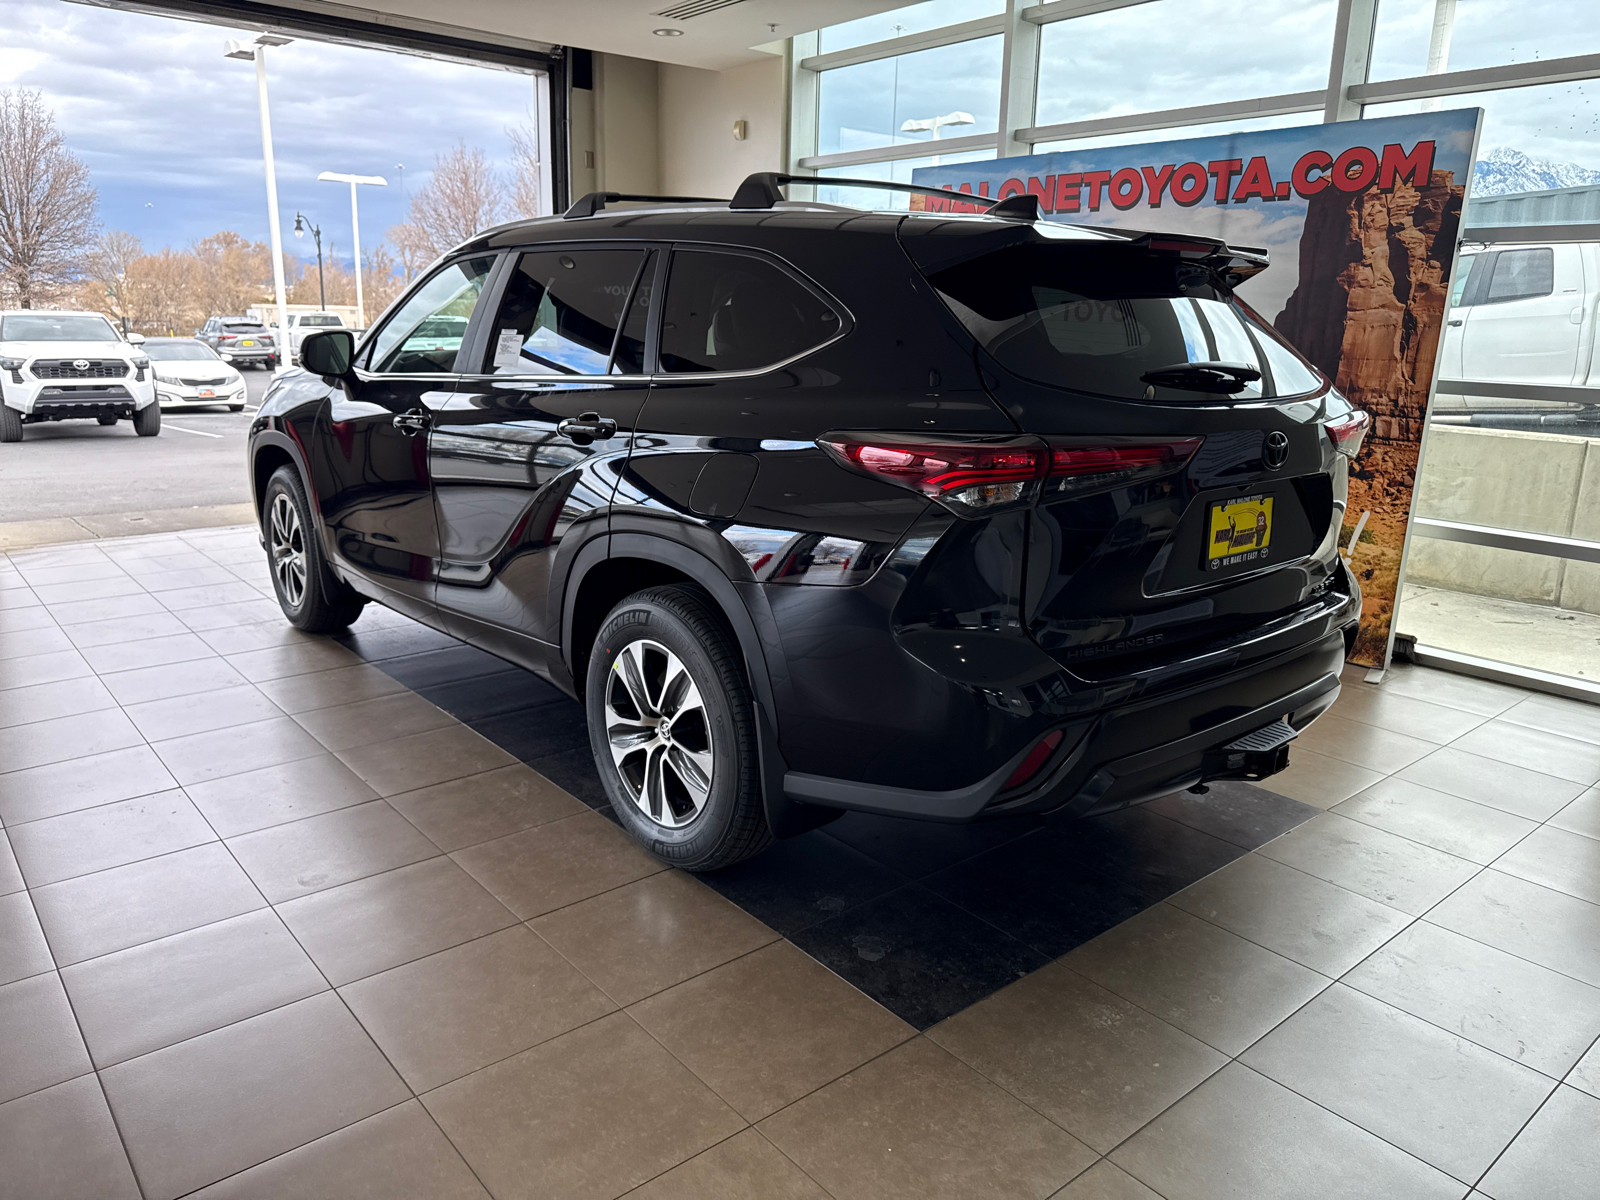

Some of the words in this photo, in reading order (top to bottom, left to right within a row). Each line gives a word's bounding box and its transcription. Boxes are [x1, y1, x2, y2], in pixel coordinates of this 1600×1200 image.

[925, 140, 1436, 214] MALONETOYOTA.COM
[1258, 516, 1265, 525] 32
[1223, 557, 1229, 566] WE
[1231, 554, 1242, 563] MAKE
[1242, 553, 1247, 561] IT
[1248, 551, 1258, 560] EASY
[602, 611, 648, 642] MICHELIN
[1066, 633, 1164, 660] HIGHLANDER
